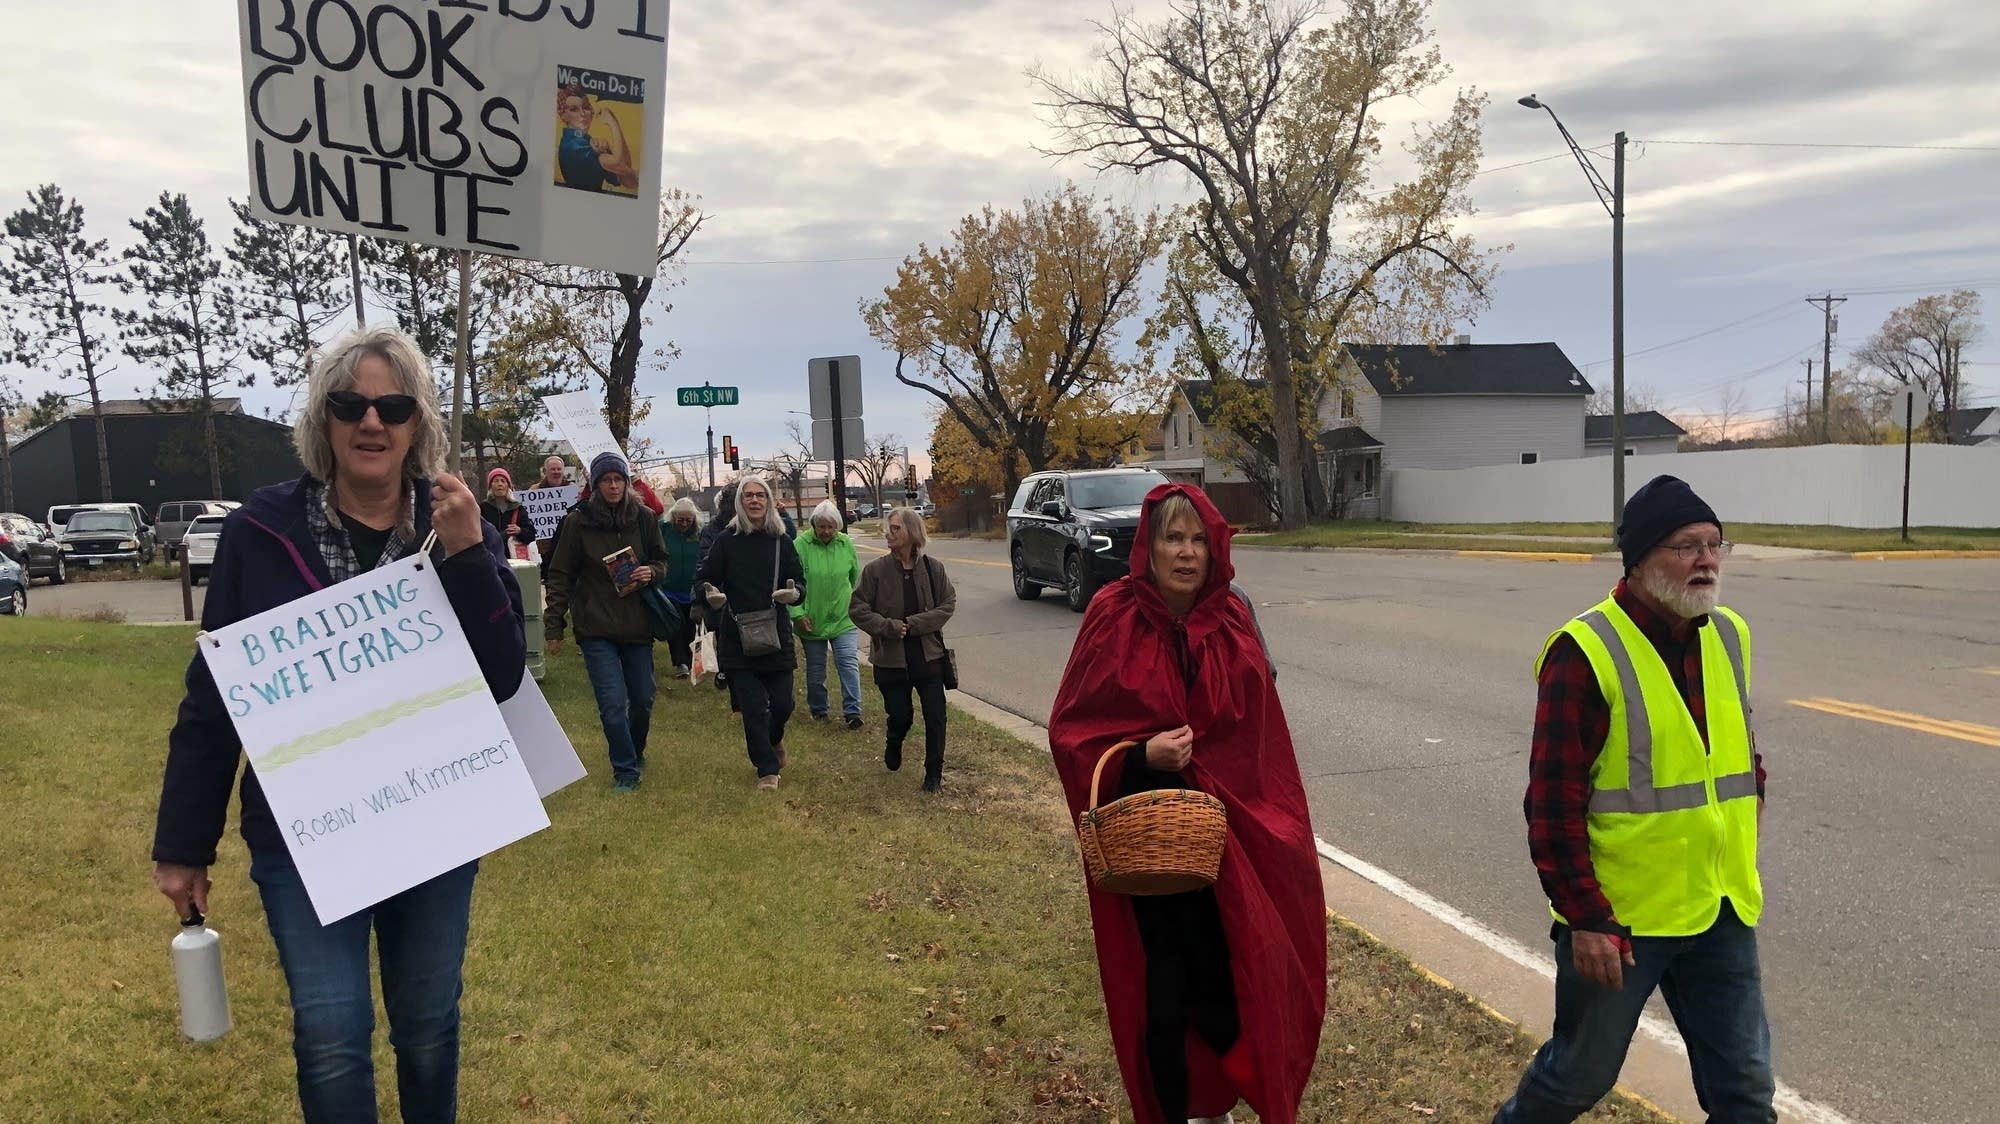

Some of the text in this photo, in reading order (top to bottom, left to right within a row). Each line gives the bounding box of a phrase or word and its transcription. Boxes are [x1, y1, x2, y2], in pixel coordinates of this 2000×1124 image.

[248, 0, 485, 91] BOOK
[559, 67, 646, 97] We Can Do It!
[250, 65, 528, 177] CLUBS
[255, 138, 520, 250] UNITE
[683, 389, 734, 403] 6th St NW
[520, 489, 563, 502] TODAY
[229, 609, 444, 717] SWEETGRASS
[241, 578, 418, 666] BRAIDING
[291, 800, 356, 846] ROBIN
